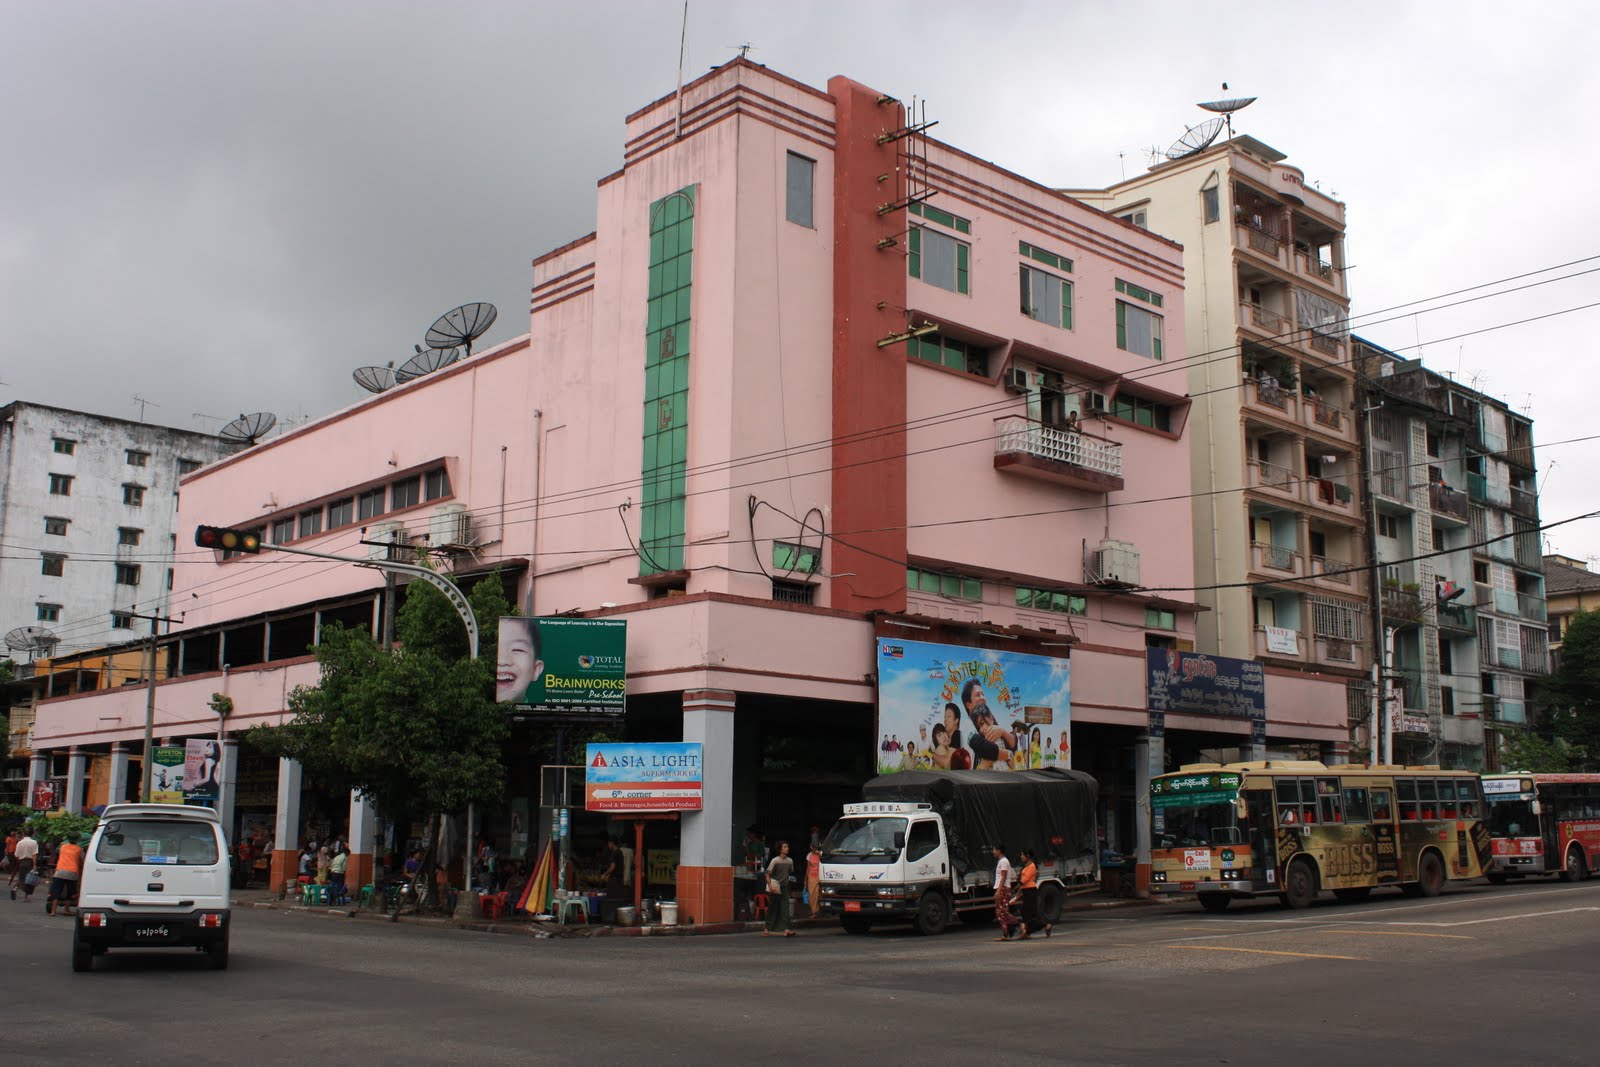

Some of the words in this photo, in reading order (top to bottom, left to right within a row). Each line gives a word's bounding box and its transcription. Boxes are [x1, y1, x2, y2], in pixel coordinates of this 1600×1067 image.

[595, 655, 623, 664] TOTAL
[588, 689, 625, 699] Pre-School
[610, 755, 645, 767] ASIA
[652, 755, 698, 767] LIGHT
[1279, 841, 1298, 861] BOSS
[1377, 842, 1394, 855] BOSS
[1325, 843, 1375, 877] BOSS
